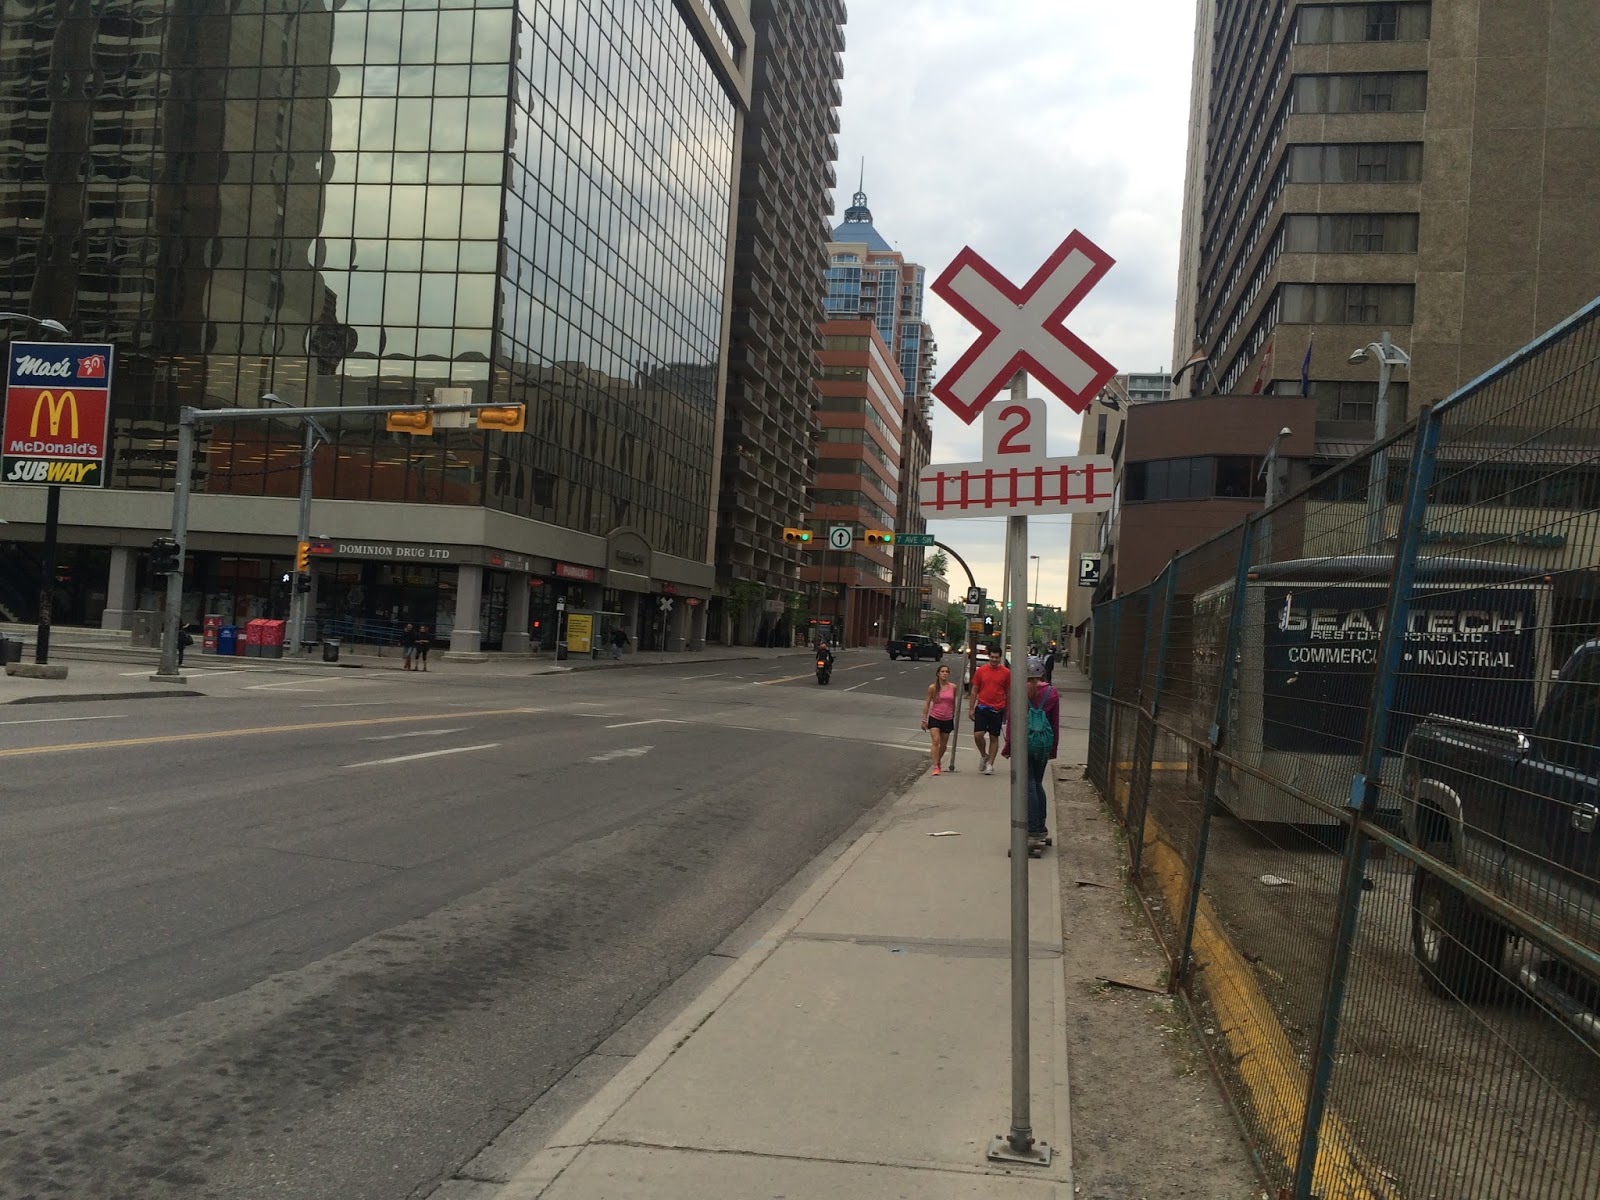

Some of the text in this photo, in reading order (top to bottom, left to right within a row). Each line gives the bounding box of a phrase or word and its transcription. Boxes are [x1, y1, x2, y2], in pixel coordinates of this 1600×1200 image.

[15, 354, 72, 378] Mac's
[997, 405, 1032, 455] 2
[10, 440, 98, 455] McDonald's
[7, 460, 98, 483] SUBWAY
[896, 535, 933, 544] 7 AVE SW
[339, 544, 393, 556] DOMINION
[395, 547, 425, 558] DRUG
[429, 549, 450, 559] LTD
[1080, 560, 1094, 577] P
[1418, 649, 1515, 668] INDUSTRIAL
